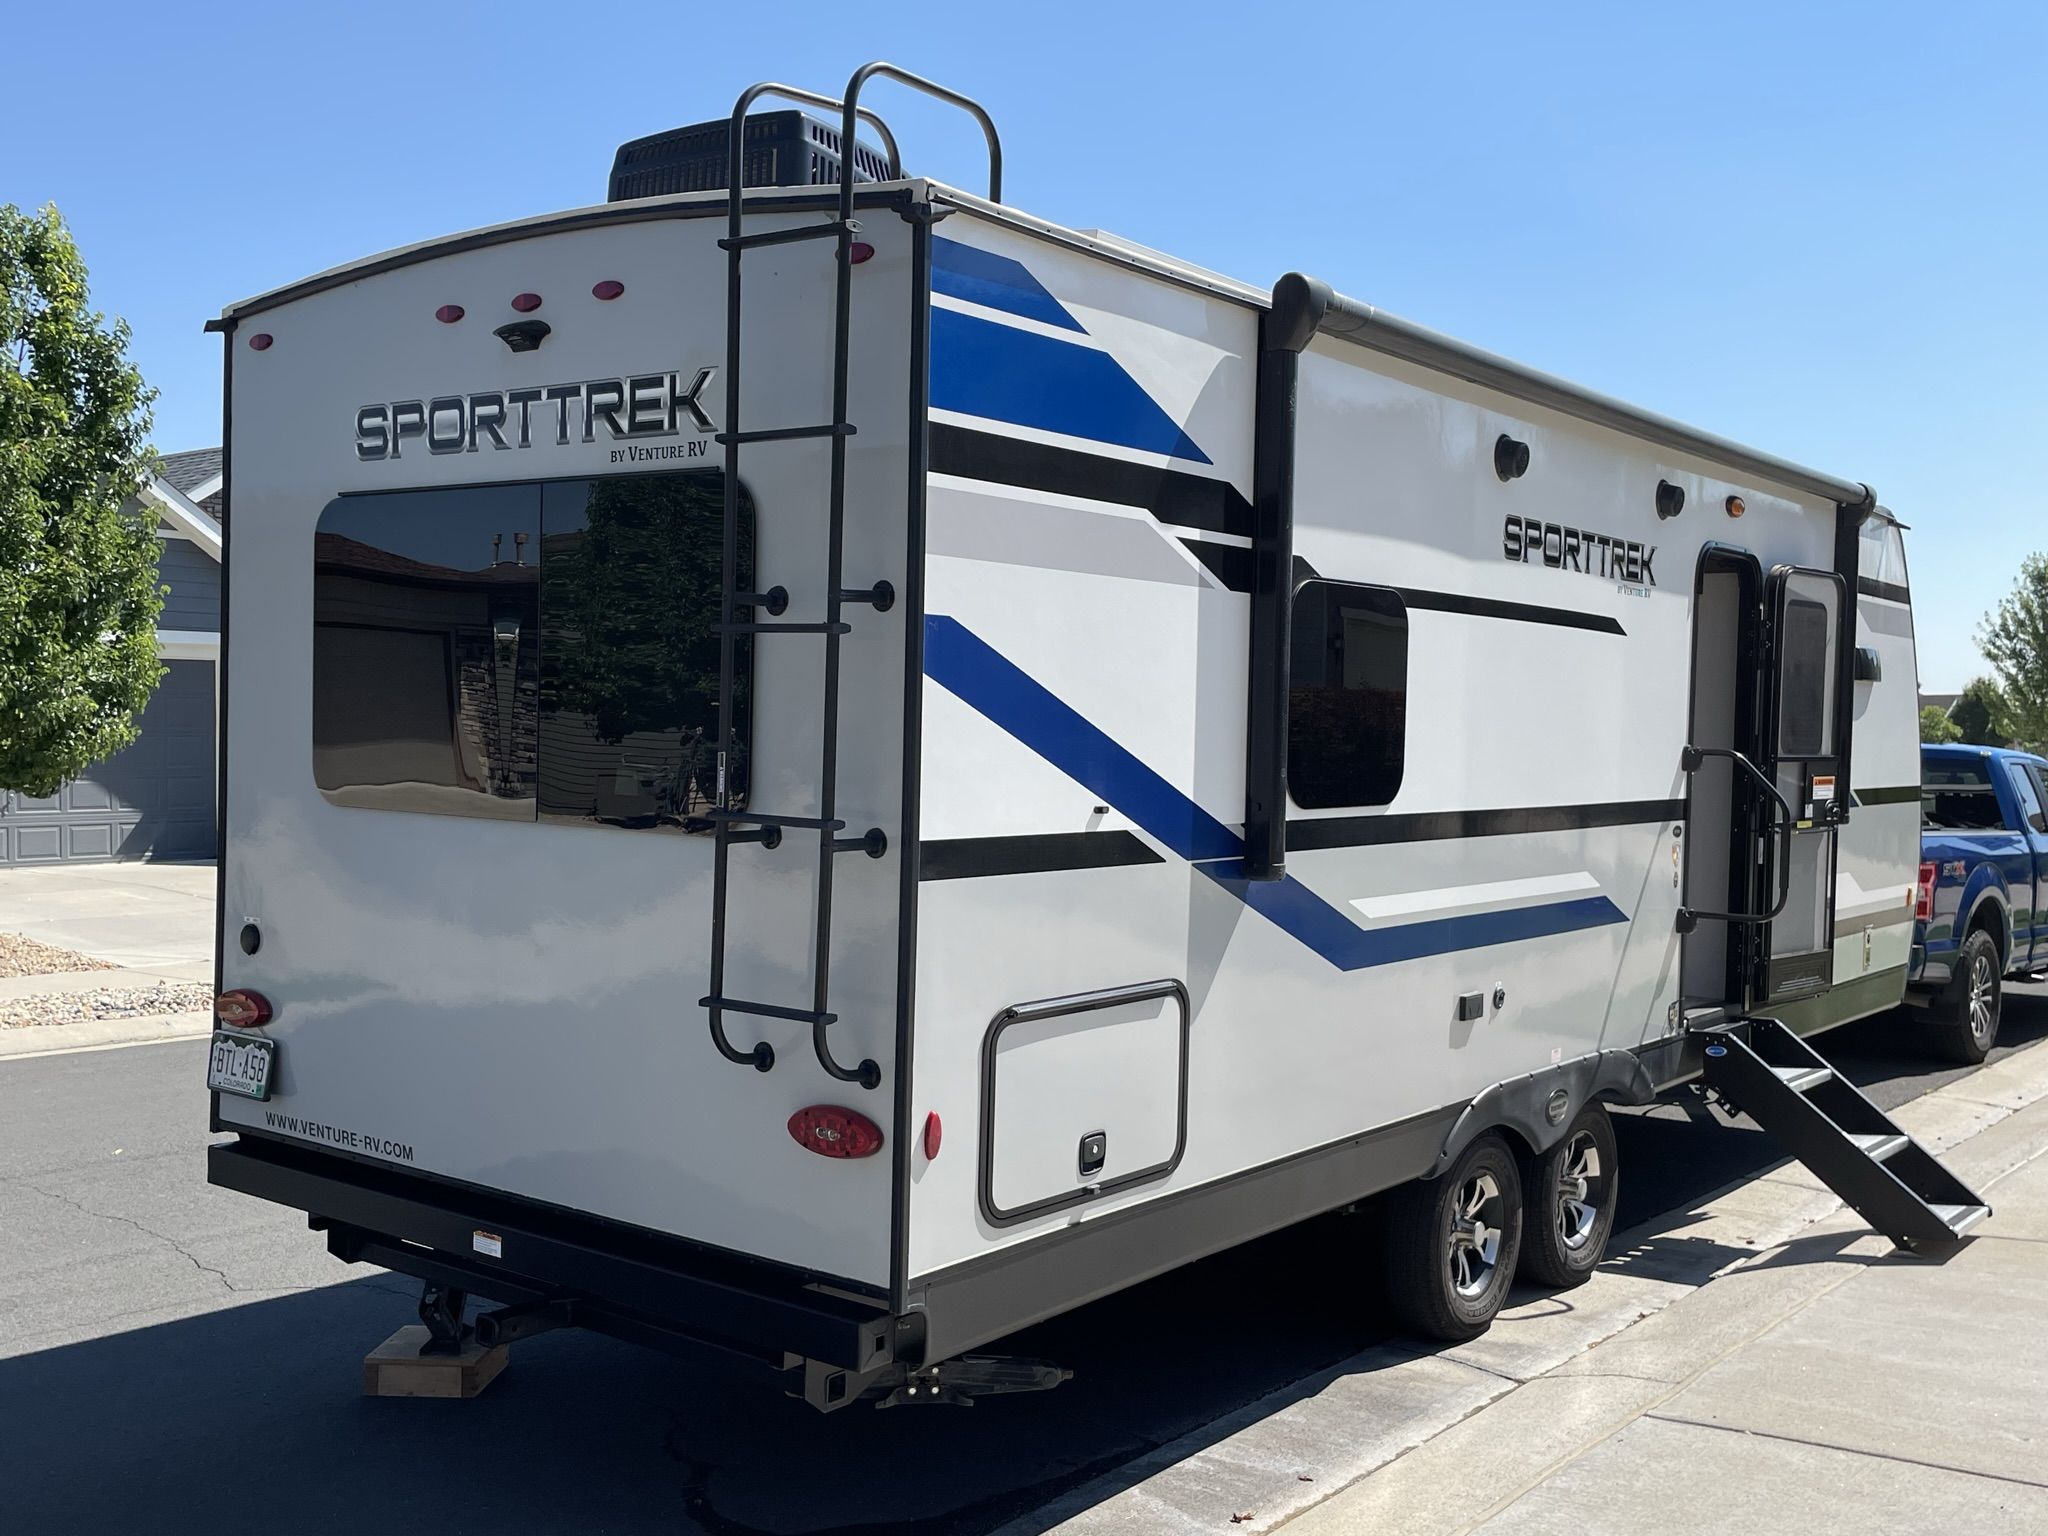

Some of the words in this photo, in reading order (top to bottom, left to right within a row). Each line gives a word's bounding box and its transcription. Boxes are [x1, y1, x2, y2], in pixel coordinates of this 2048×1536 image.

[356, 365, 718, 461] SPORTTREK
[611, 450, 625, 463] BY
[628, 446, 685, 461] VENTURE
[688, 440, 708, 457] RV
[1503, 514, 1658, 586] SPORTTREK
[265, 1111, 414, 1161] WWW.VENTURE-RV.COM
